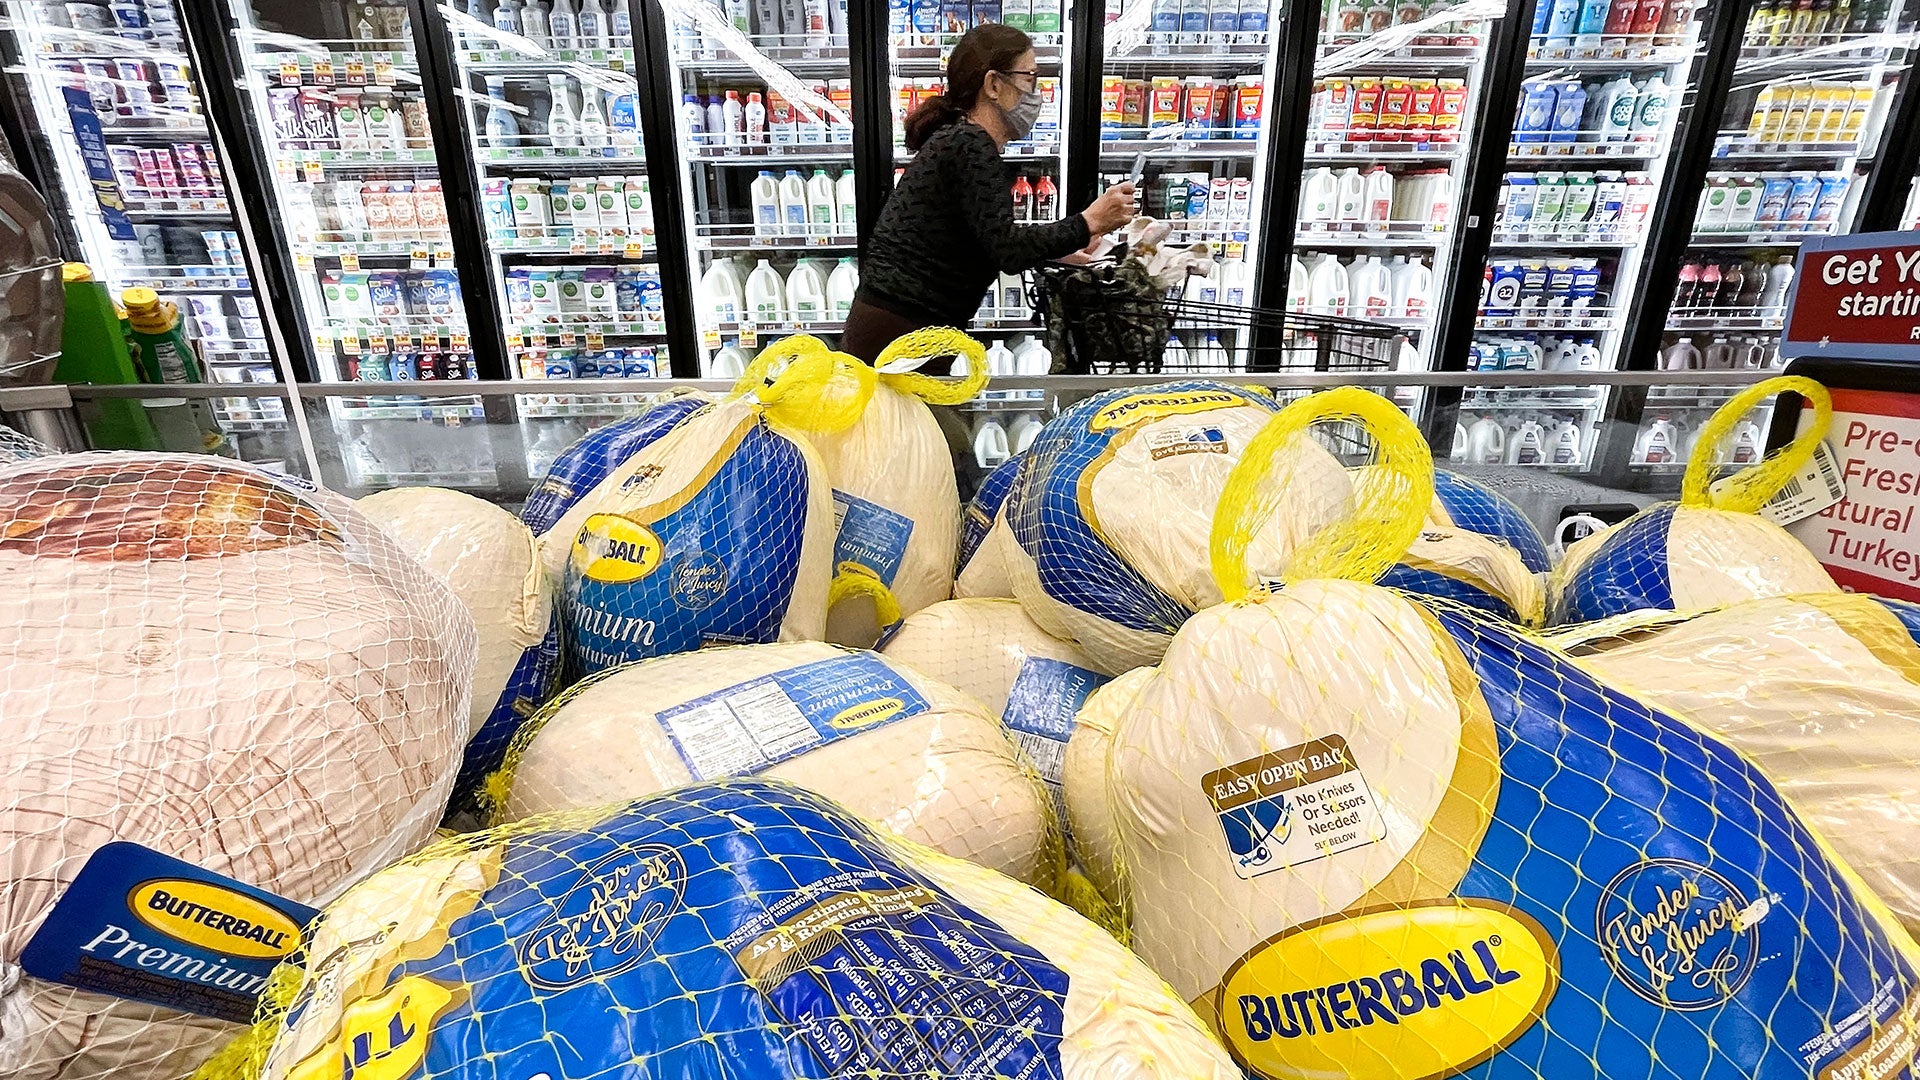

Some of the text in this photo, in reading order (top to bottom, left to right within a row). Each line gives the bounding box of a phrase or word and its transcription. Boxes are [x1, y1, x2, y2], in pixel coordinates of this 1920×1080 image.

[1822, 253, 1882, 286] Get
[373, 286, 394, 300] Silk
[427, 285, 448, 300] Silk
[1499, 287, 1513, 298] a2
[422, 369, 436, 380] Silk
[447, 369, 462, 380] Silk
[1845, 421, 1920, 454] Pre-
[1819, 496, 1914, 533] atural
[567, 600, 655, 646] emium
[1213, 774, 1258, 800] EASY
[1261, 758, 1308, 786] OPEN
[1296, 780, 1355, 807] No Knives
[1302, 795, 1367, 821] Or Scssors
[1308, 811, 1362, 837] Needed!
[1329, 831, 1357, 847] BELOW
[528, 865, 631, 961] Tender
[592, 856, 677, 947] Juicy
[1605, 878, 1698, 957] Tender
[752, 895, 861, 959] Aproximate
[798, 904, 871, 943] Roasting
[849, 915, 883, 931] THAW
[833, 957, 867, 990] people)
[853, 937, 909, 998] In Refrigerator
[887, 958, 918, 987] (DAYS)
[846, 992, 878, 1026] FEEDS
[879, 1020, 899, 1040] 6-12
[911, 991, 930, 1010] 3-4
[890, 988, 971, 1057] 12-15 4-5 9-11
[937, 1020, 956, 1039] 5-6
[964, 998, 986, 1017] 11-12
[798, 1011, 840, 1064] WEIGHT
[828, 1021, 853, 1052] (lbs)
[952, 1035, 969, 1054] 6-7
[975, 1013, 998, 1034] 12-15
